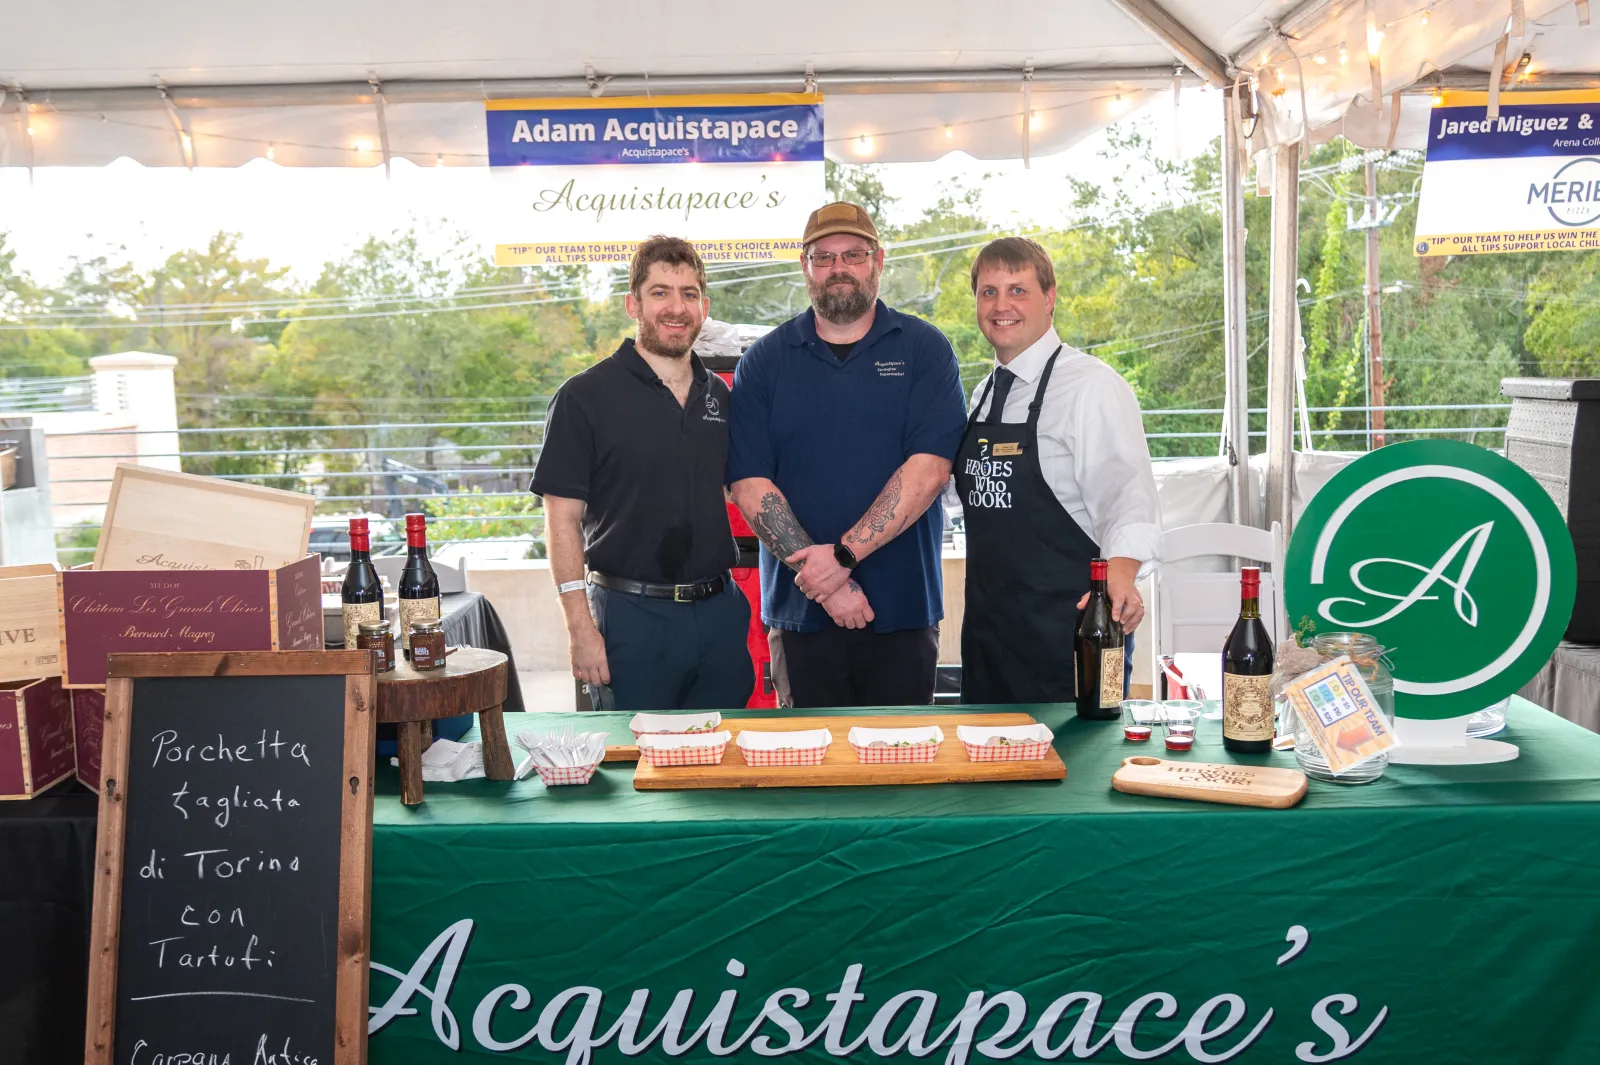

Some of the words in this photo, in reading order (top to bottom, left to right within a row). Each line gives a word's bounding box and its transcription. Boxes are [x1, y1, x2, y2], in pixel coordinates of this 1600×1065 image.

[511, 118, 596, 143] Adam
[602, 116, 798, 147] Acquistapace
[1437, 118, 1491, 139] Jared
[1497, 115, 1568, 137] Miguez
[1577, 113, 1593, 130] &
[621, 146, 689, 158] Acquistapace's
[1552, 139, 1580, 147] Arena
[532, 174, 787, 223] Acquistapace's
[508, 246, 533, 255] "TIP"
[535, 246, 556, 254] OUR
[559, 245, 586, 253] TEAM
[588, 245, 601, 253] TO
[604, 244, 628, 253] HELP
[630, 244, 637, 252] U
[735, 241, 771, 250] CHOICE
[773, 241, 803, 250] AWAR
[1426, 237, 1451, 245] "TIP"
[1453, 236, 1473, 244] OUR
[1476, 235, 1501, 243] TEAM
[1503, 234, 1516, 242] TO
[1518, 233, 1541, 241] HELP
[1543, 232, 1555, 240] US
[1557, 231, 1577, 239] WIN
[1580, 231, 1598, 239] THE
[1461, 245, 1479, 253] ALL
[1481, 244, 1501, 252] TIPS
[1502, 241, 1544, 251] SUPPORT
[1547, 240, 1576, 249] LOCAL
[1579, 239, 1600, 248] CHIL
[545, 255, 563, 263] ALL
[567, 254, 586, 263] TIPS
[588, 253, 632, 262] SUPPORT
[700, 252, 732, 260] ABUSE
[734, 251, 776, 260] VICTIMS.
[964, 458, 1013, 477] HEROES
[968, 489, 1013, 509] COOK!
[136, 553, 217, 570] Acquist
[159, 595, 213, 619] Grands
[119, 626, 170, 639] Bernard
[170, 626, 216, 643] Magrez
[1341, 672, 1355, 687] TIP
[1351, 688, 1368, 709] OUR
[1364, 707, 1386, 736] TEAM
[152, 729, 311, 768] Porchetta
[139, 848, 166, 880] di
[183, 848, 300, 880] Torino
[180, 904, 245, 927] con
[148, 934, 276, 970] Tartufi
[369, 918, 1389, 1065] Acquistapace's
